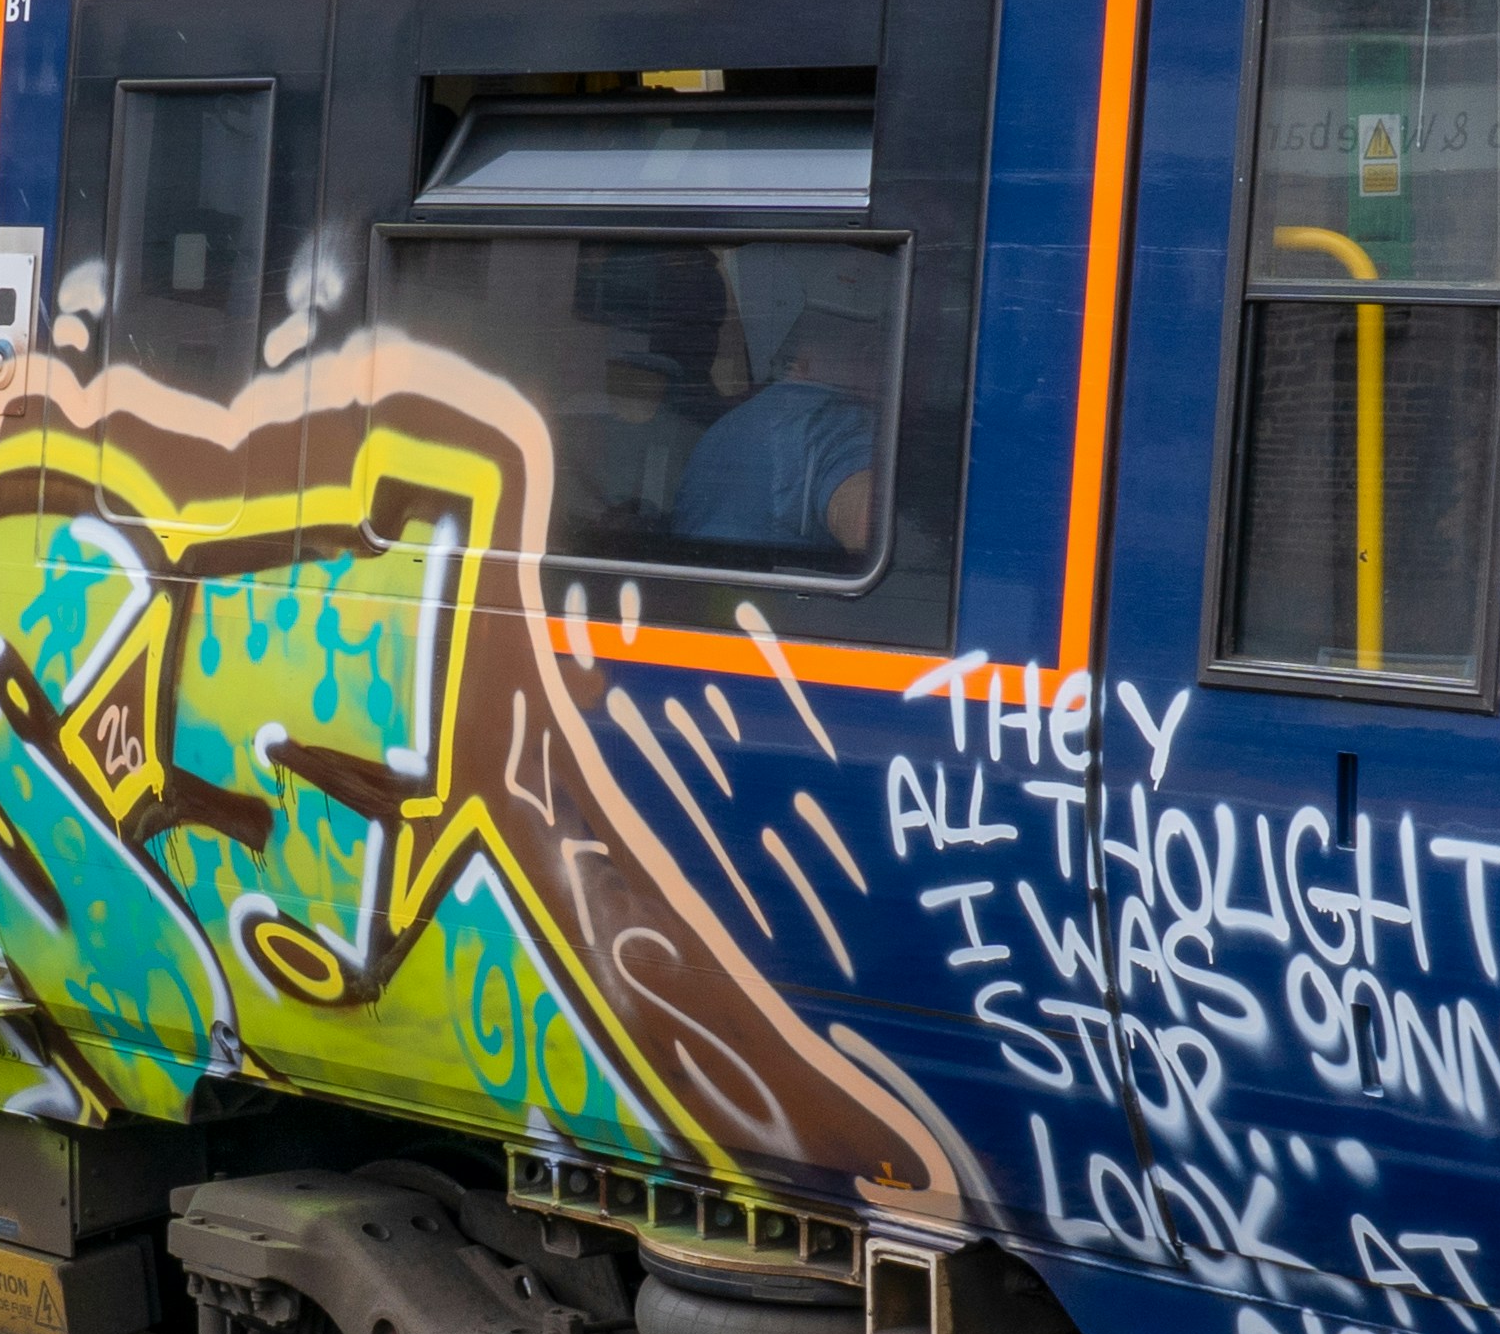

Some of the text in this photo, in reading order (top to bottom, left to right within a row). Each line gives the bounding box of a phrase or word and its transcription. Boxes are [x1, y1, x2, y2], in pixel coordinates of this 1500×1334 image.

[96, 703, 143, 775] 26
[886, 754, 1019, 858] ALL
[920, 880, 1012, 968] I
[1018, 879, 1268, 1046] WAS
[1030, 1113, 1364, 1309] LOOK
